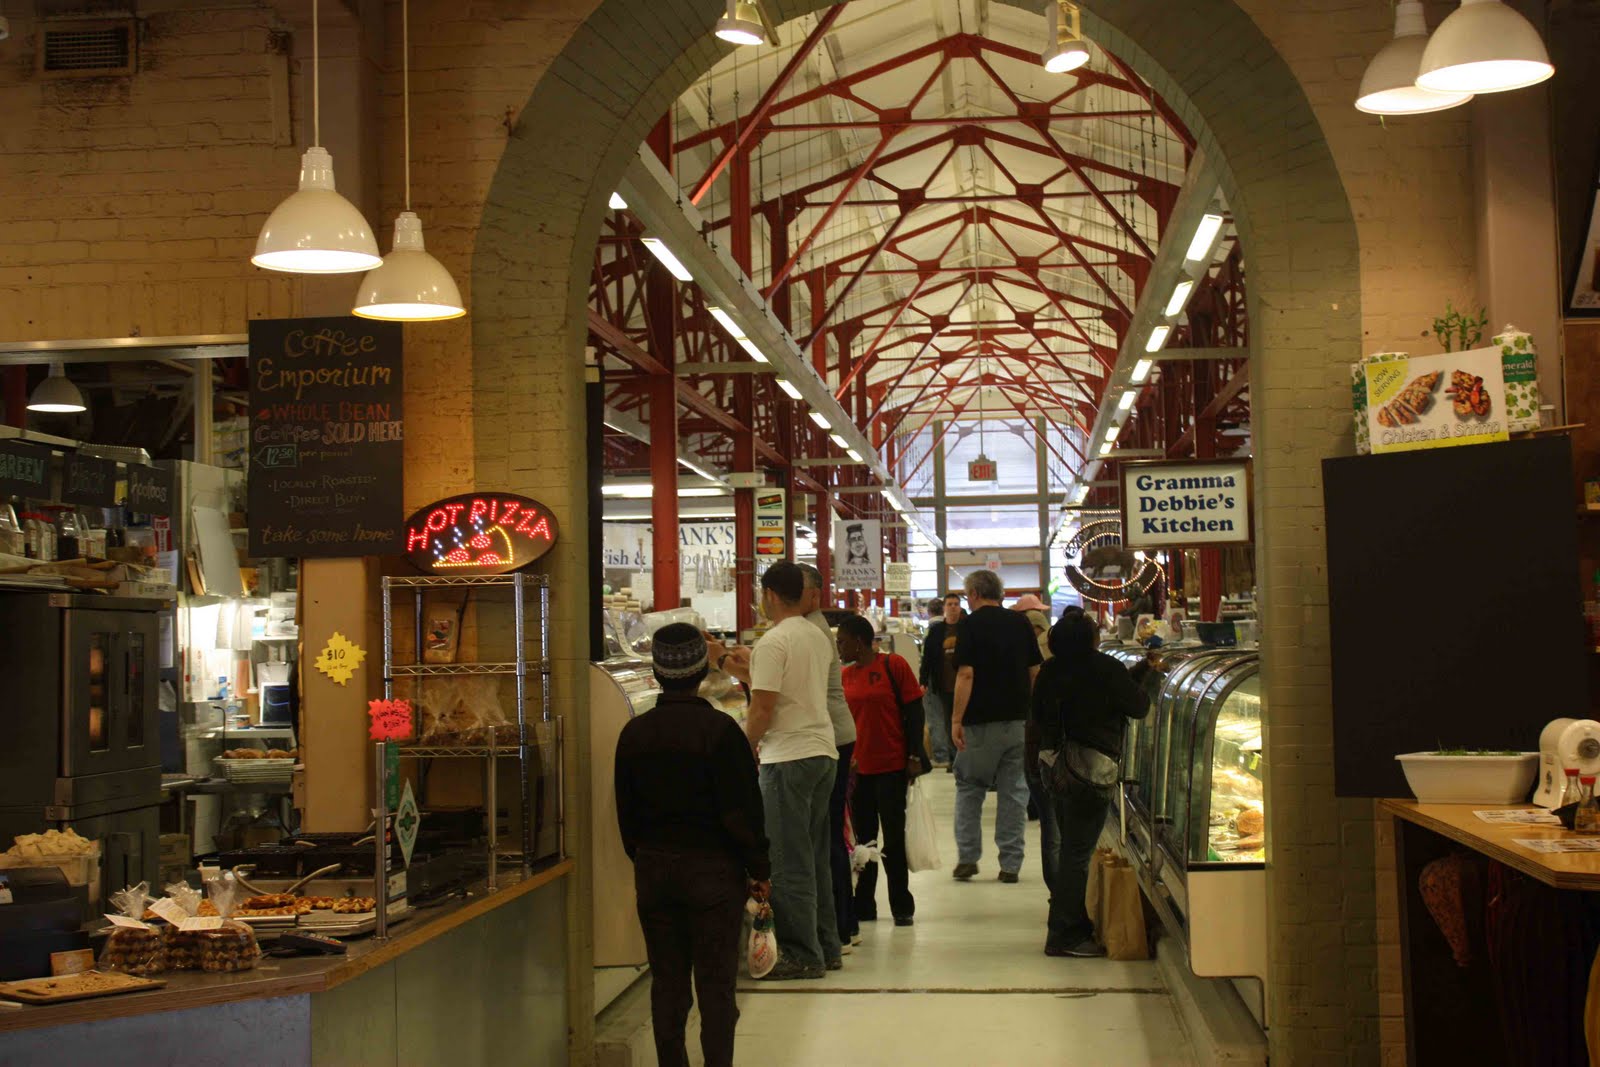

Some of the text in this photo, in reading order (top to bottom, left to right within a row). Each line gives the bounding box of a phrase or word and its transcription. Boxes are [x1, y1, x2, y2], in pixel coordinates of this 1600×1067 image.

[284, 328, 377, 358] Coffee
[1373, 367, 1389, 385] NOW
[1503, 360, 1532, 370] merald
[257, 358, 392, 400] Emporium
[1374, 369, 1402, 398] SERVING
[272, 400, 391, 422] WHOLE BEAN
[255, 420, 404, 446] Coffee SOLD HERE
[1381, 420, 1501, 445] Chicken & Shrimp
[0, 453, 44, 485] GREEN
[1136, 475, 1236, 491] Gramma
[1139, 494, 1235, 512] Debbie's
[262, 522, 395, 545] take some home
[407, 499, 552, 552] HOT PIZZA
[679, 525, 734, 546] ANK'S
[1142, 517, 1234, 534] Kitchen
[841, 567, 877, 575] FRANK'S
[326, 648, 346, 661] $10
